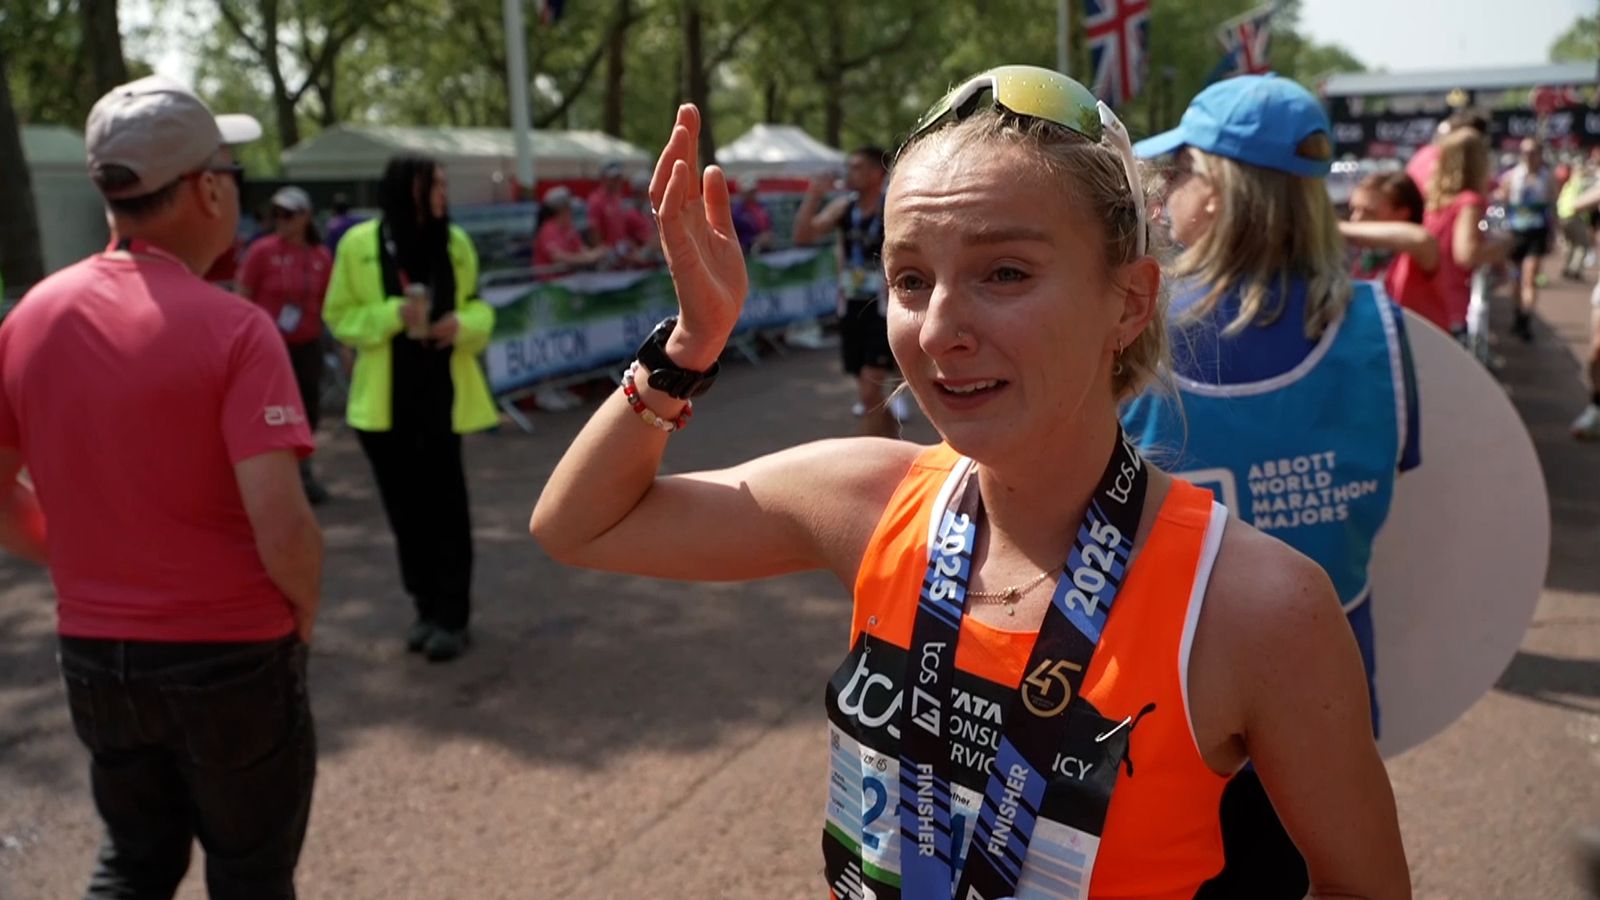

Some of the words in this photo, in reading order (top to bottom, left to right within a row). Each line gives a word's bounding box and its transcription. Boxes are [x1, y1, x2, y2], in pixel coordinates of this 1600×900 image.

[505, 326, 588, 376] BUXTON
[1105, 461, 1135, 504] tcs
[1248, 451, 1336, 480] ABBOTT
[1248, 471, 1332, 497] WORLD
[1251, 480, 1378, 514] MARATHON
[1254, 504, 1349, 530] MAJORS
[929, 513, 969, 601] 2025
[1065, 520, 1122, 618] 2025
[919, 642, 947, 684] tcs
[916, 763, 935, 857] FINISHER
[987, 764, 1030, 857] FINISHER
